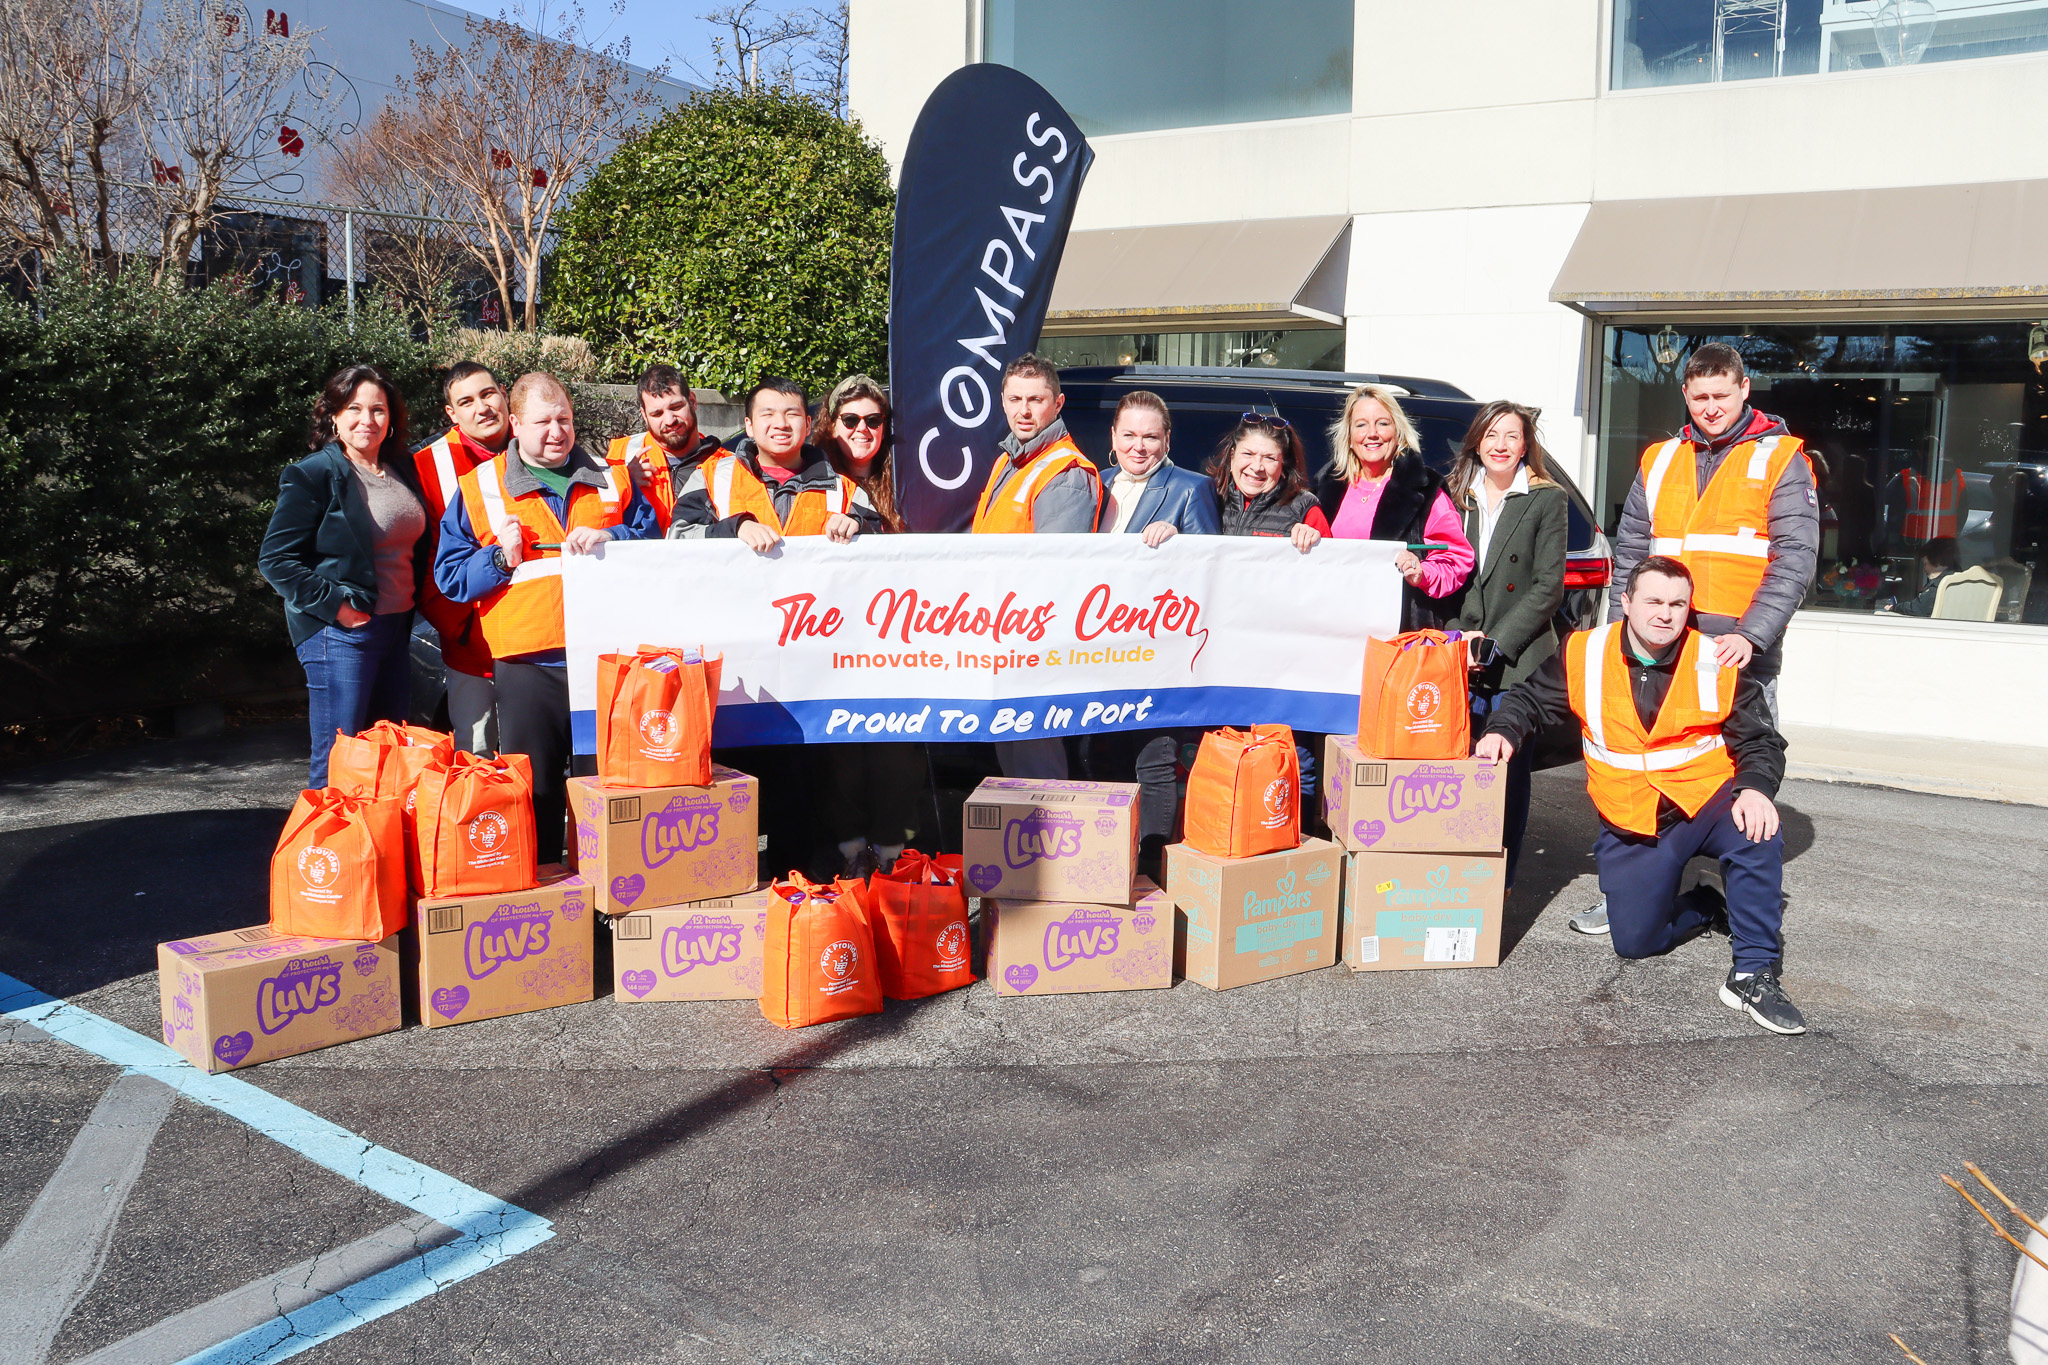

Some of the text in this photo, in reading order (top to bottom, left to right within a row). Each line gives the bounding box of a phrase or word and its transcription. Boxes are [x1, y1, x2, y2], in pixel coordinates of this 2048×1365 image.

[918, 111, 1068, 490] COMPASS
[771, 583, 1208, 673] The Nicholas Center
[833, 645, 1155, 675] Innovate, Inspire & Include
[1407, 689, 1419, 707] Port
[825, 695, 1154, 735] Proud To Be In Port
[1419, 765, 1428, 774] 12
[407, 790, 417, 809] Por
[672, 797, 683, 807] 12
[1391, 778, 1458, 819] Luvs
[1034, 809, 1045, 818] 12
[470, 821, 480, 840] Port
[646, 813, 716, 865] Luvs
[1007, 822, 1078, 866] Luvs
[299, 851, 309, 870] Port
[618, 879, 625, 889] 5
[1385, 878, 1469, 908] Pampers
[499, 905, 510, 916] 12
[1074, 910, 1084, 919] 12
[1244, 890, 1312, 920] Pampers
[692, 915, 703, 924] 12
[1310, 917, 1317, 927] 4
[1467, 914, 1475, 924] 4
[469, 921, 546, 976] Luvs
[665, 930, 737, 974] Luvs
[1047, 925, 1116, 968] Luvs
[289, 960, 300, 971] 12
[822, 947, 834, 967] Port
[629, 972, 636, 981] 6
[1012, 967, 1019, 976] 6
[261, 974, 337, 1031] Luvs
[440, 990, 447, 1001] 5
[222, 1038, 230, 1048] 6
